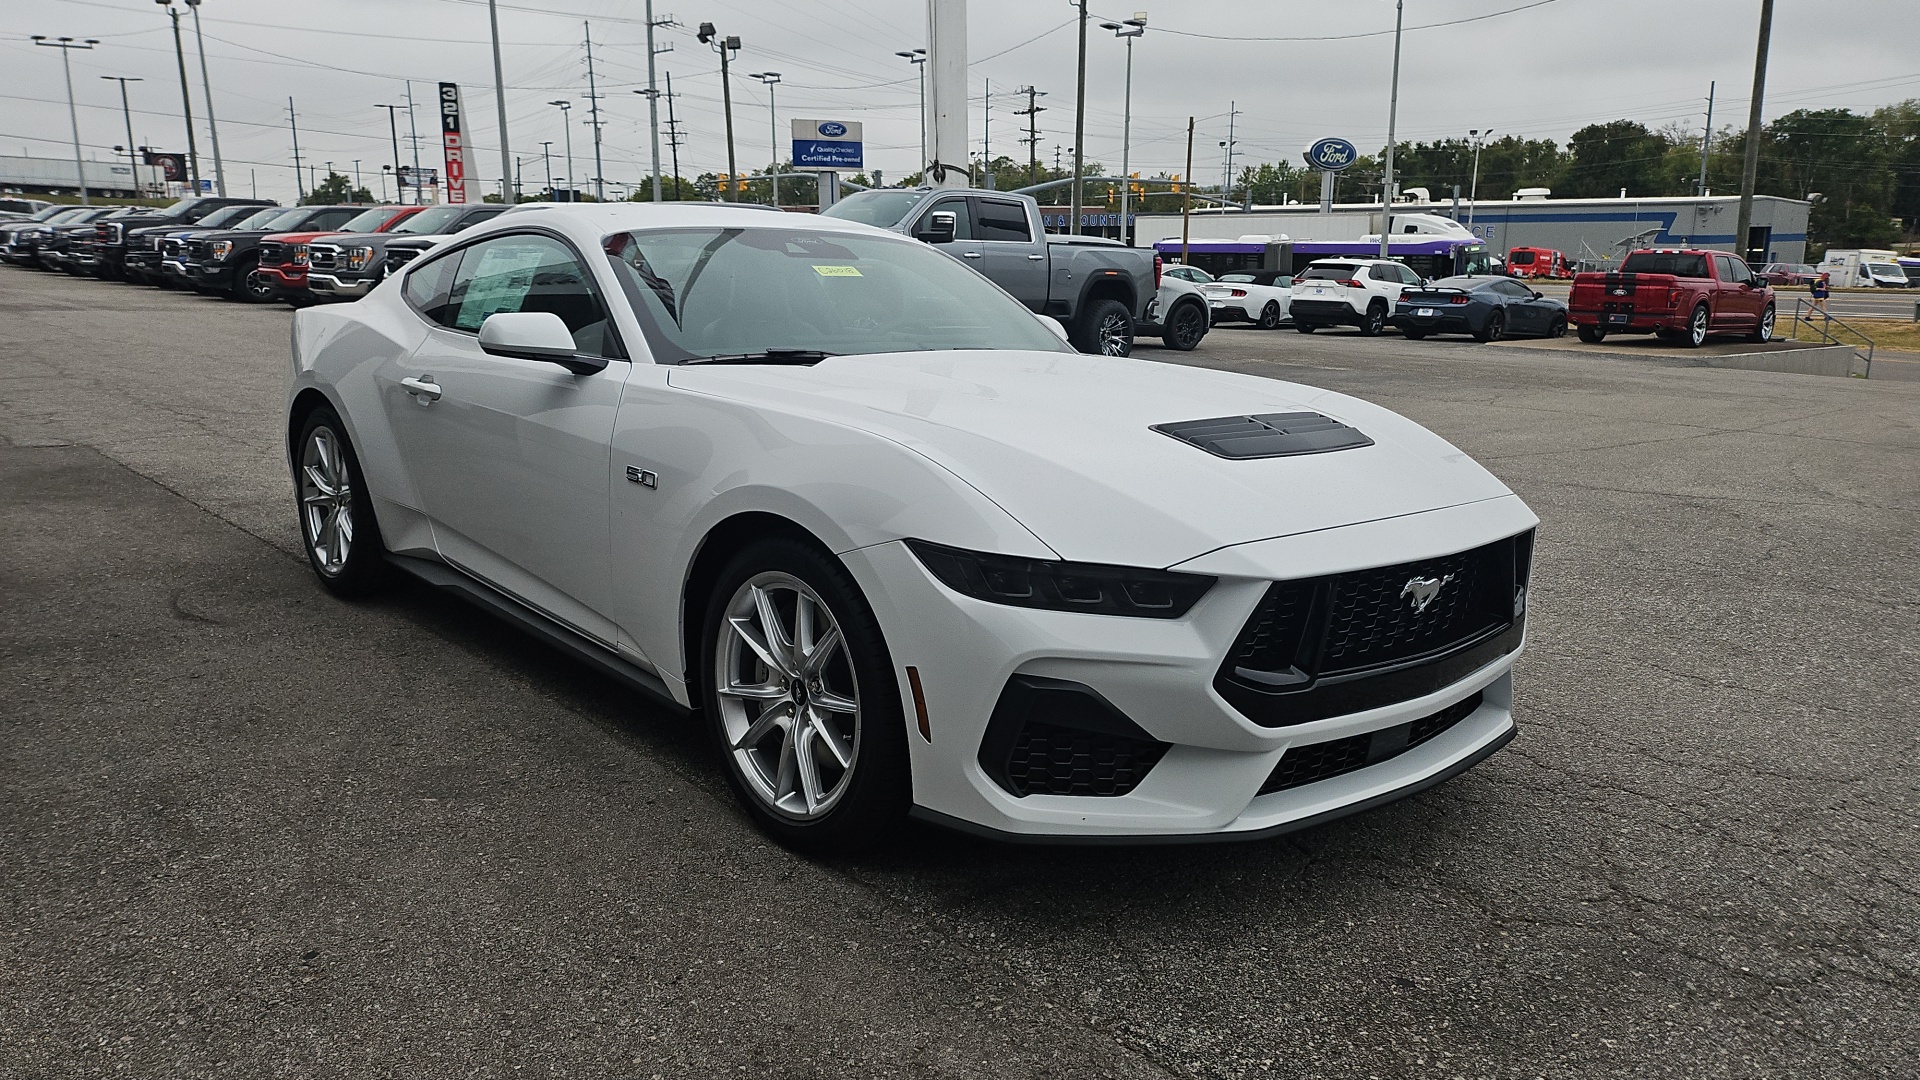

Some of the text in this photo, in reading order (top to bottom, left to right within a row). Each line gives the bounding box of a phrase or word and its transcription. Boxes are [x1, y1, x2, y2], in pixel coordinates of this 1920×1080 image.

[825, 124, 843, 134] Ford
[442, 87, 464, 203] 321 DRIVE
[1320, 143, 1349, 163] Ford
[1080, 214, 1135, 227] OUNTRY
